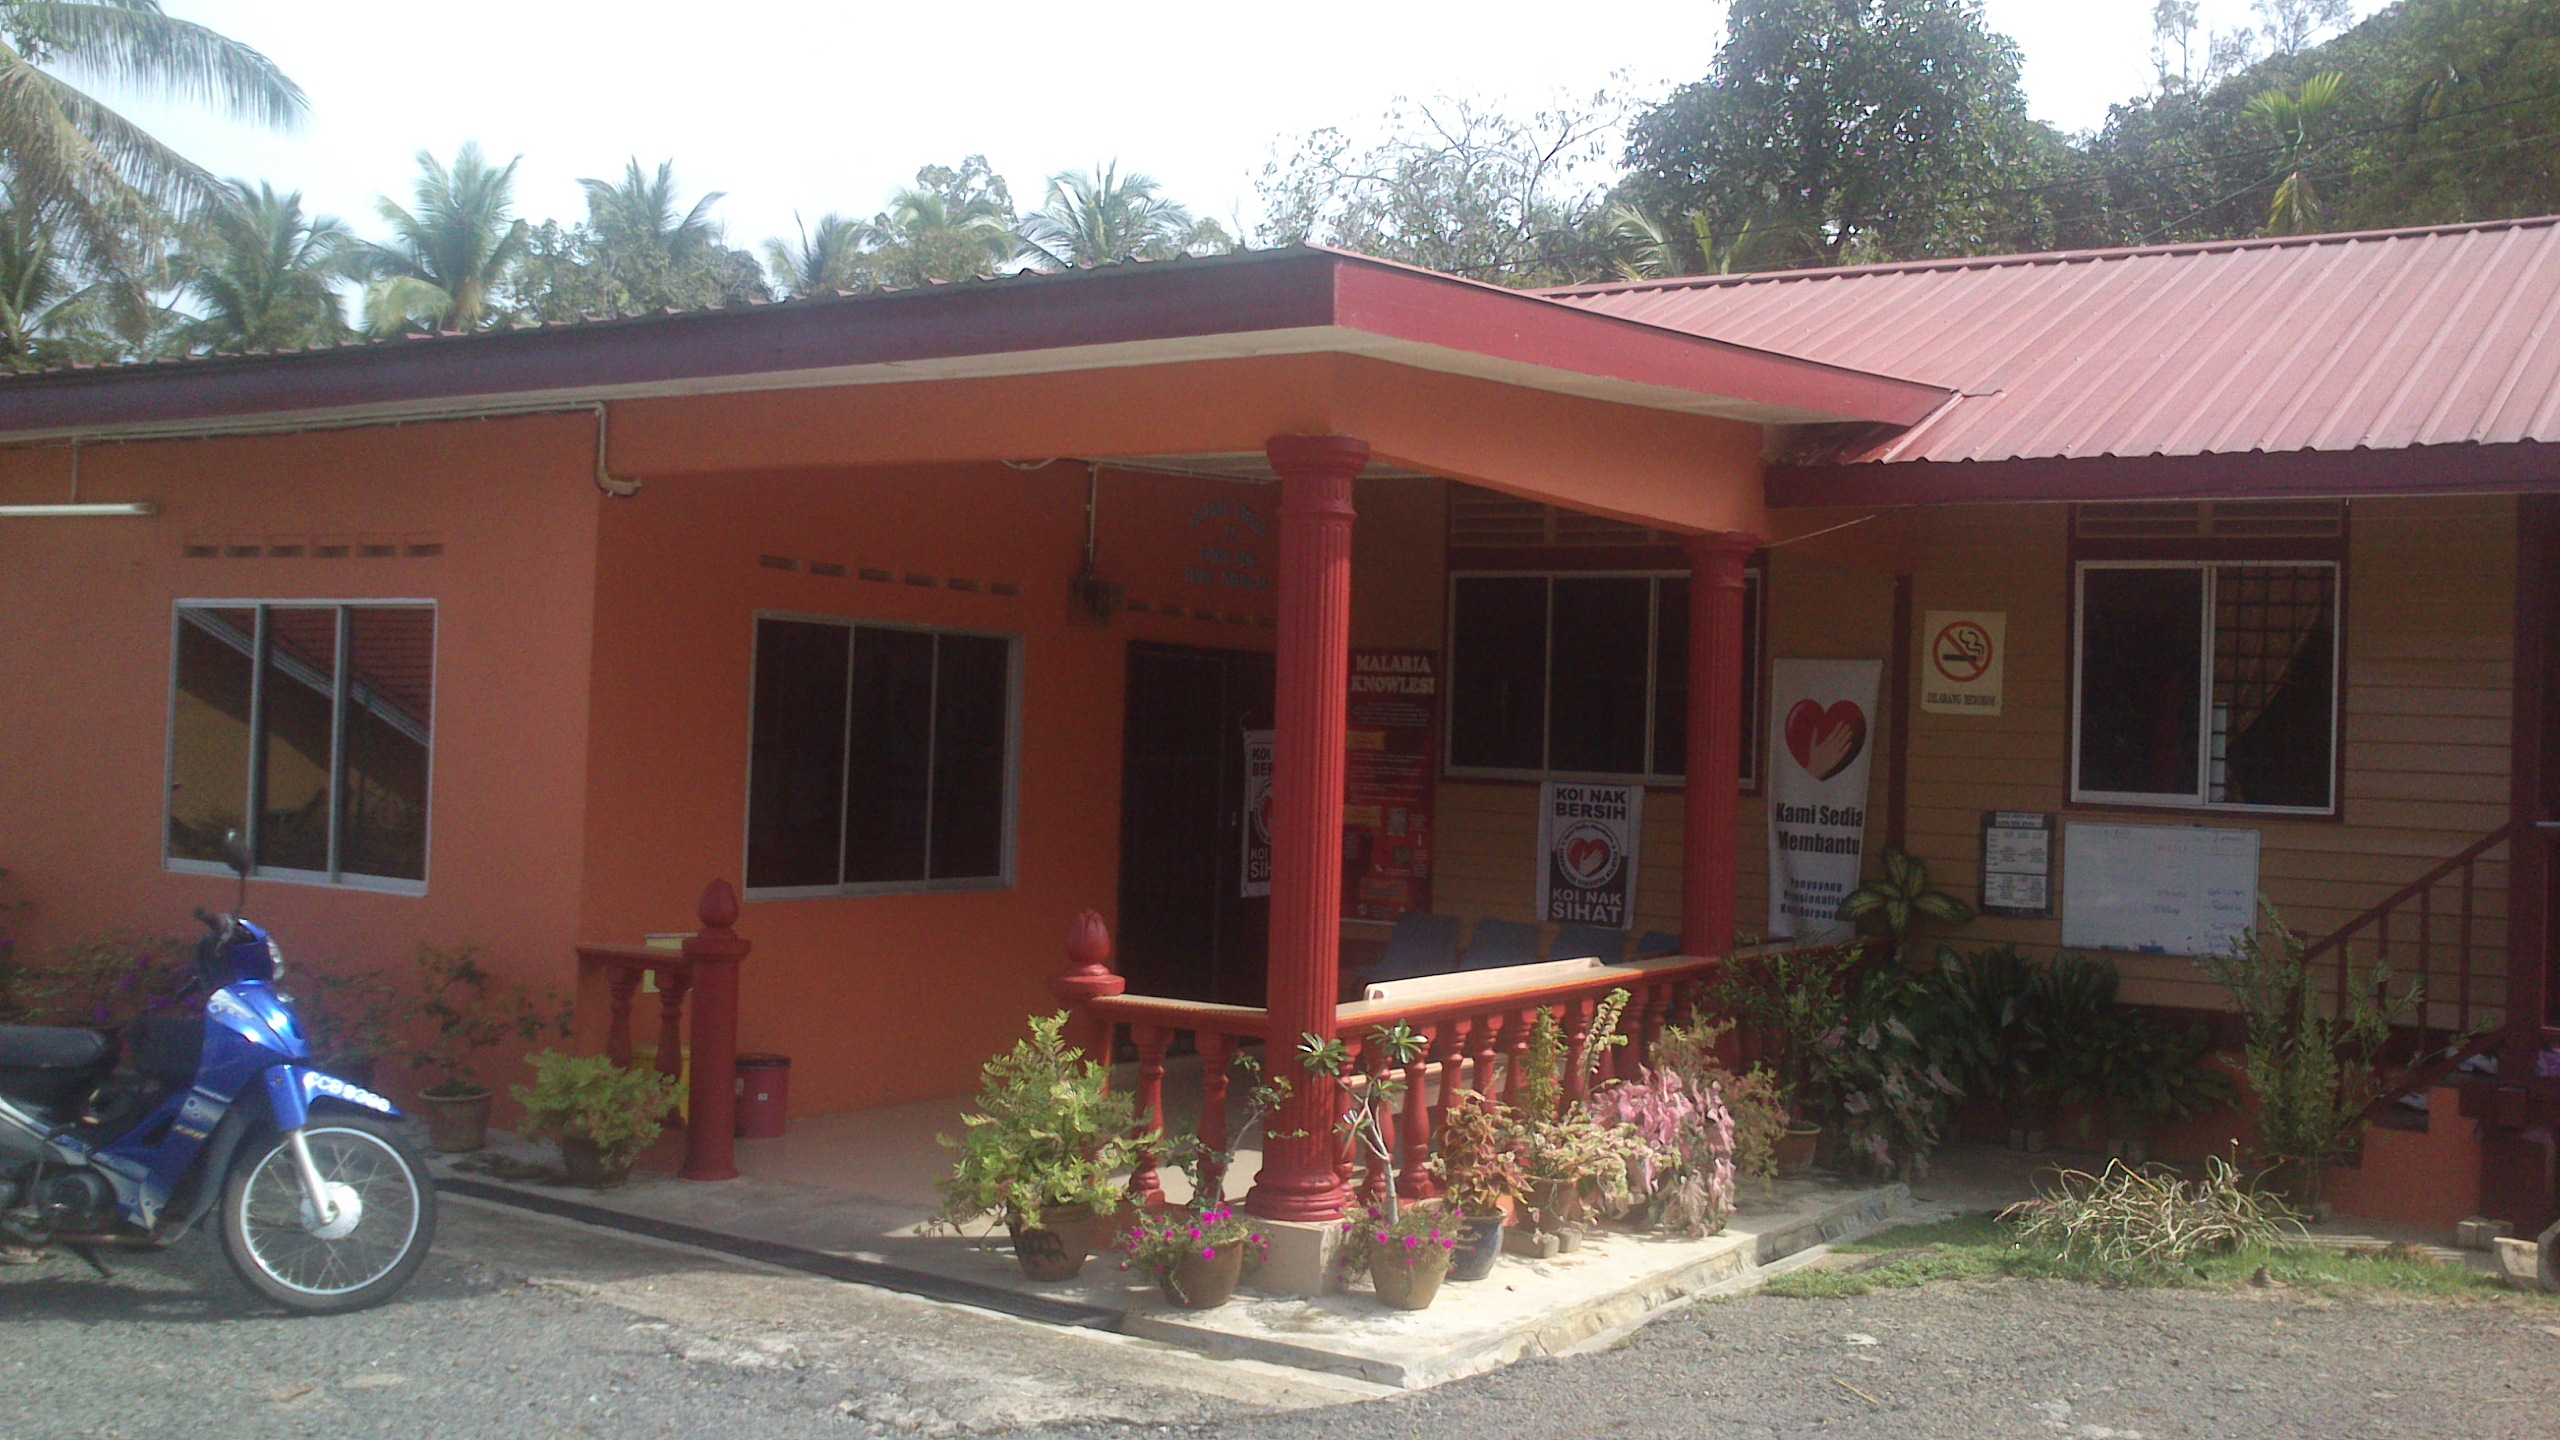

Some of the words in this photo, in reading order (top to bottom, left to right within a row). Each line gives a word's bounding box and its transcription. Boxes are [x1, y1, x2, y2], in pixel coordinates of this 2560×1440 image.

[1355, 654, 1431, 673] MALARIA
[1351, 675, 1436, 695] KNOWLESI
[1252, 762, 1275, 777] BER
[1556, 788, 1583, 801] KOI
[1590, 789, 1627, 804] NAK
[1555, 802, 1627, 821] BERSIH
[1776, 803, 1816, 824] Kami
[1819, 805, 1864, 828] Sedia
[1777, 830, 1861, 855] Membantu
[1552, 888, 1579, 902] KOI
[1586, 891, 1622, 905] NAK
[1552, 902, 1622, 923] SIHAT
